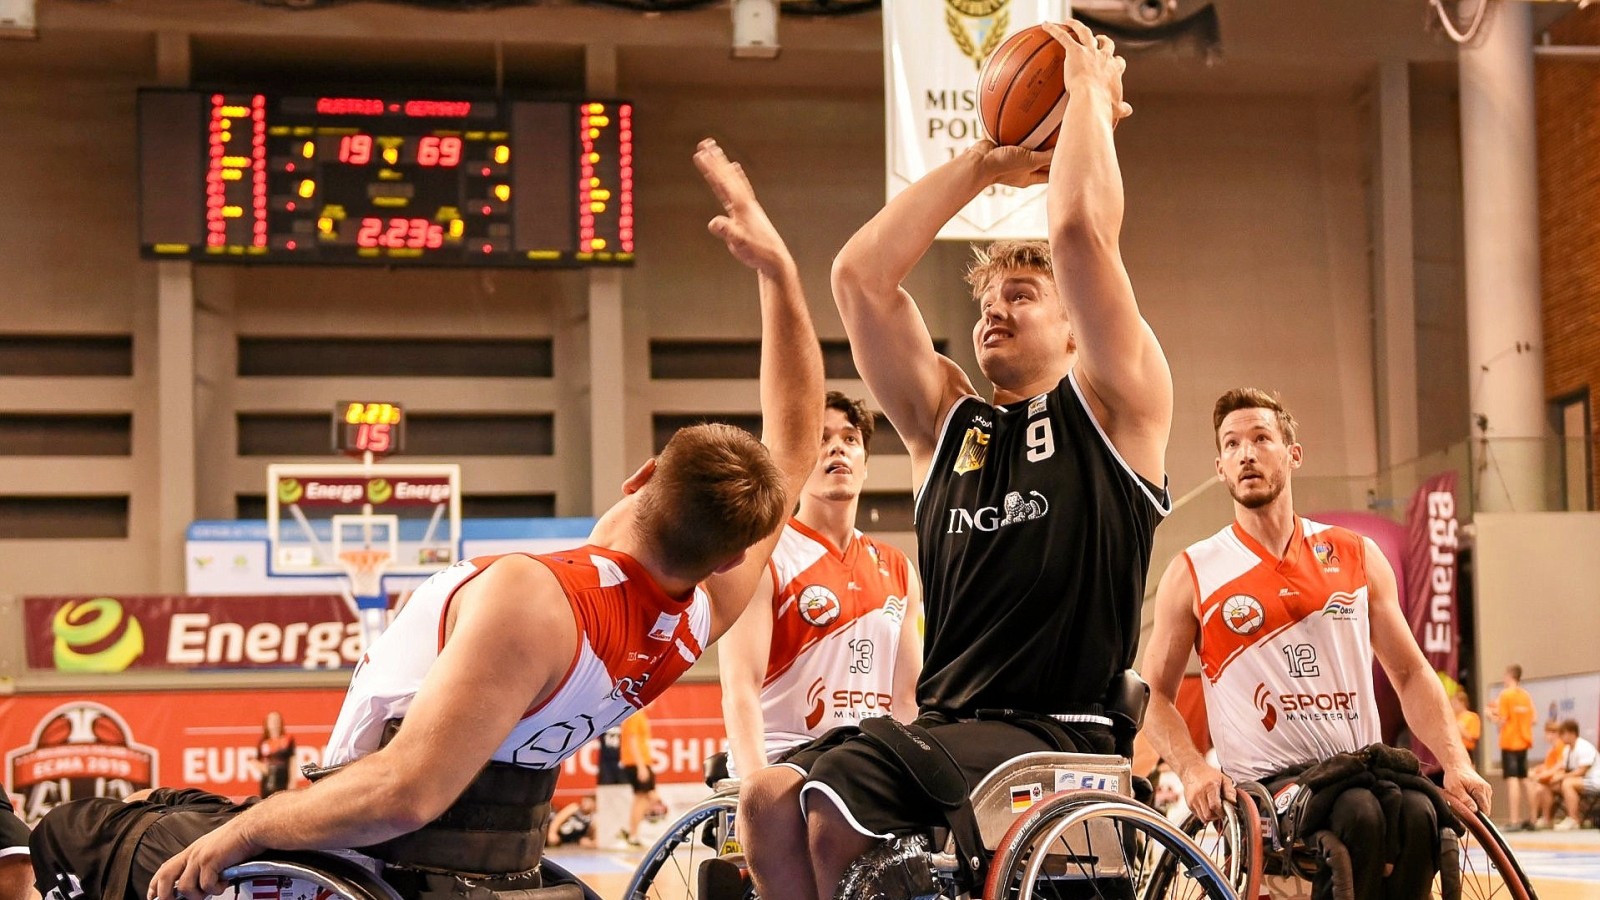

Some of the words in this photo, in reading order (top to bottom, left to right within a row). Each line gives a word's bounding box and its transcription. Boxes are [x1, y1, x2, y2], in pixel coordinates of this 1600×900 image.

[338, 134, 373, 165] 19
[417, 136, 462, 167] 69
[357, 424, 390, 451] 15
[1026, 417, 1055, 463] 9
[305, 482, 363, 503] Energa
[394, 482, 450, 503] Energa
[947, 506, 1000, 534] ING
[1425, 492, 1458, 653] Energa
[166, 613, 364, 669] Energa
[848, 638, 874, 674] 13
[1283, 644, 1320, 678] 12
[1279, 692, 1357, 711] SPORT
